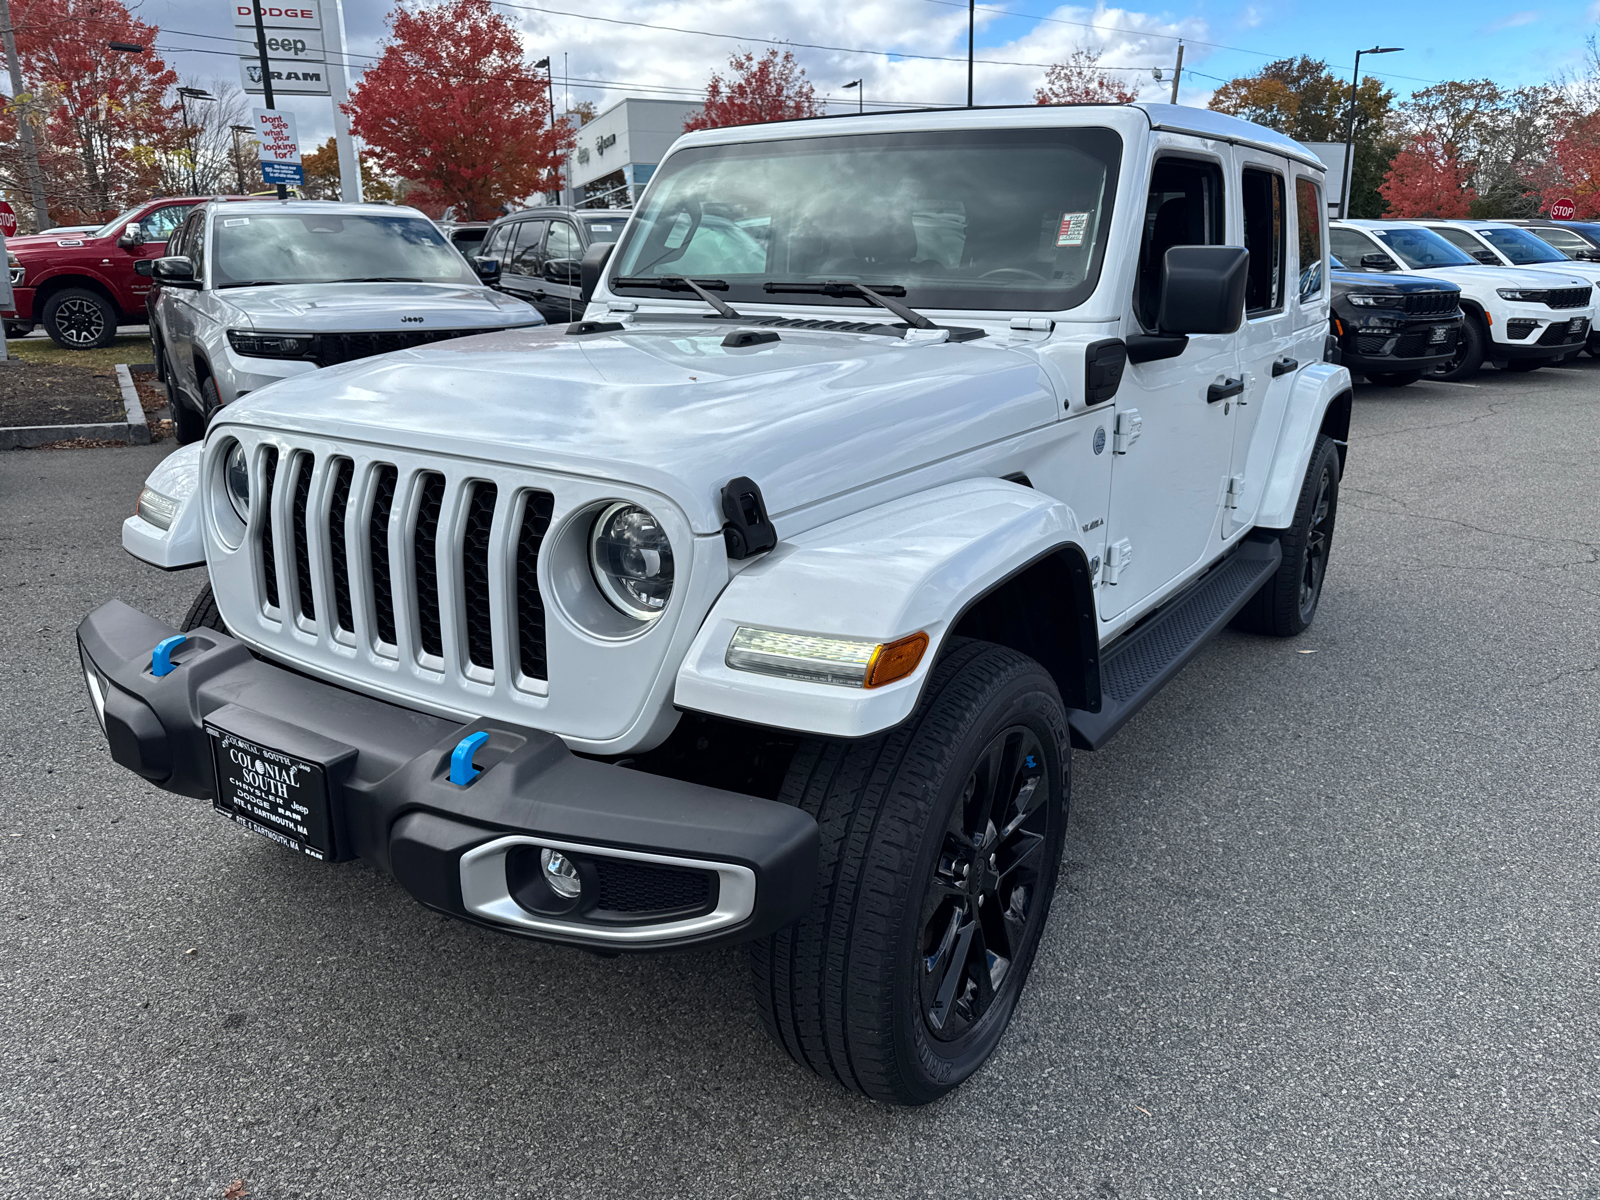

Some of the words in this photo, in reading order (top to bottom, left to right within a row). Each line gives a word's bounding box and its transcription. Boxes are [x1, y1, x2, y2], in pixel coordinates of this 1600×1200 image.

[269, 71, 321, 82] RAM
[271, 122, 288, 130] see
[262, 129, 284, 137] what
[272, 135, 290, 144] your
[262, 142, 297, 152] looking
[274, 150, 293, 159] for?
[1552, 205, 1573, 217] STOP
[400, 315, 424, 324] Jeep
[230, 748, 300, 788] COLONIAL
[242, 768, 289, 799] SOUTH
[229, 777, 284, 806] CHRYSLER
[290, 800, 309, 816] Jeep
[237, 789, 271, 810] DODGE
[277, 807, 302, 821] RAM
[297, 824, 308, 836] MA
[290, 840, 300, 851] MA
[304, 848, 323, 861] RAM
